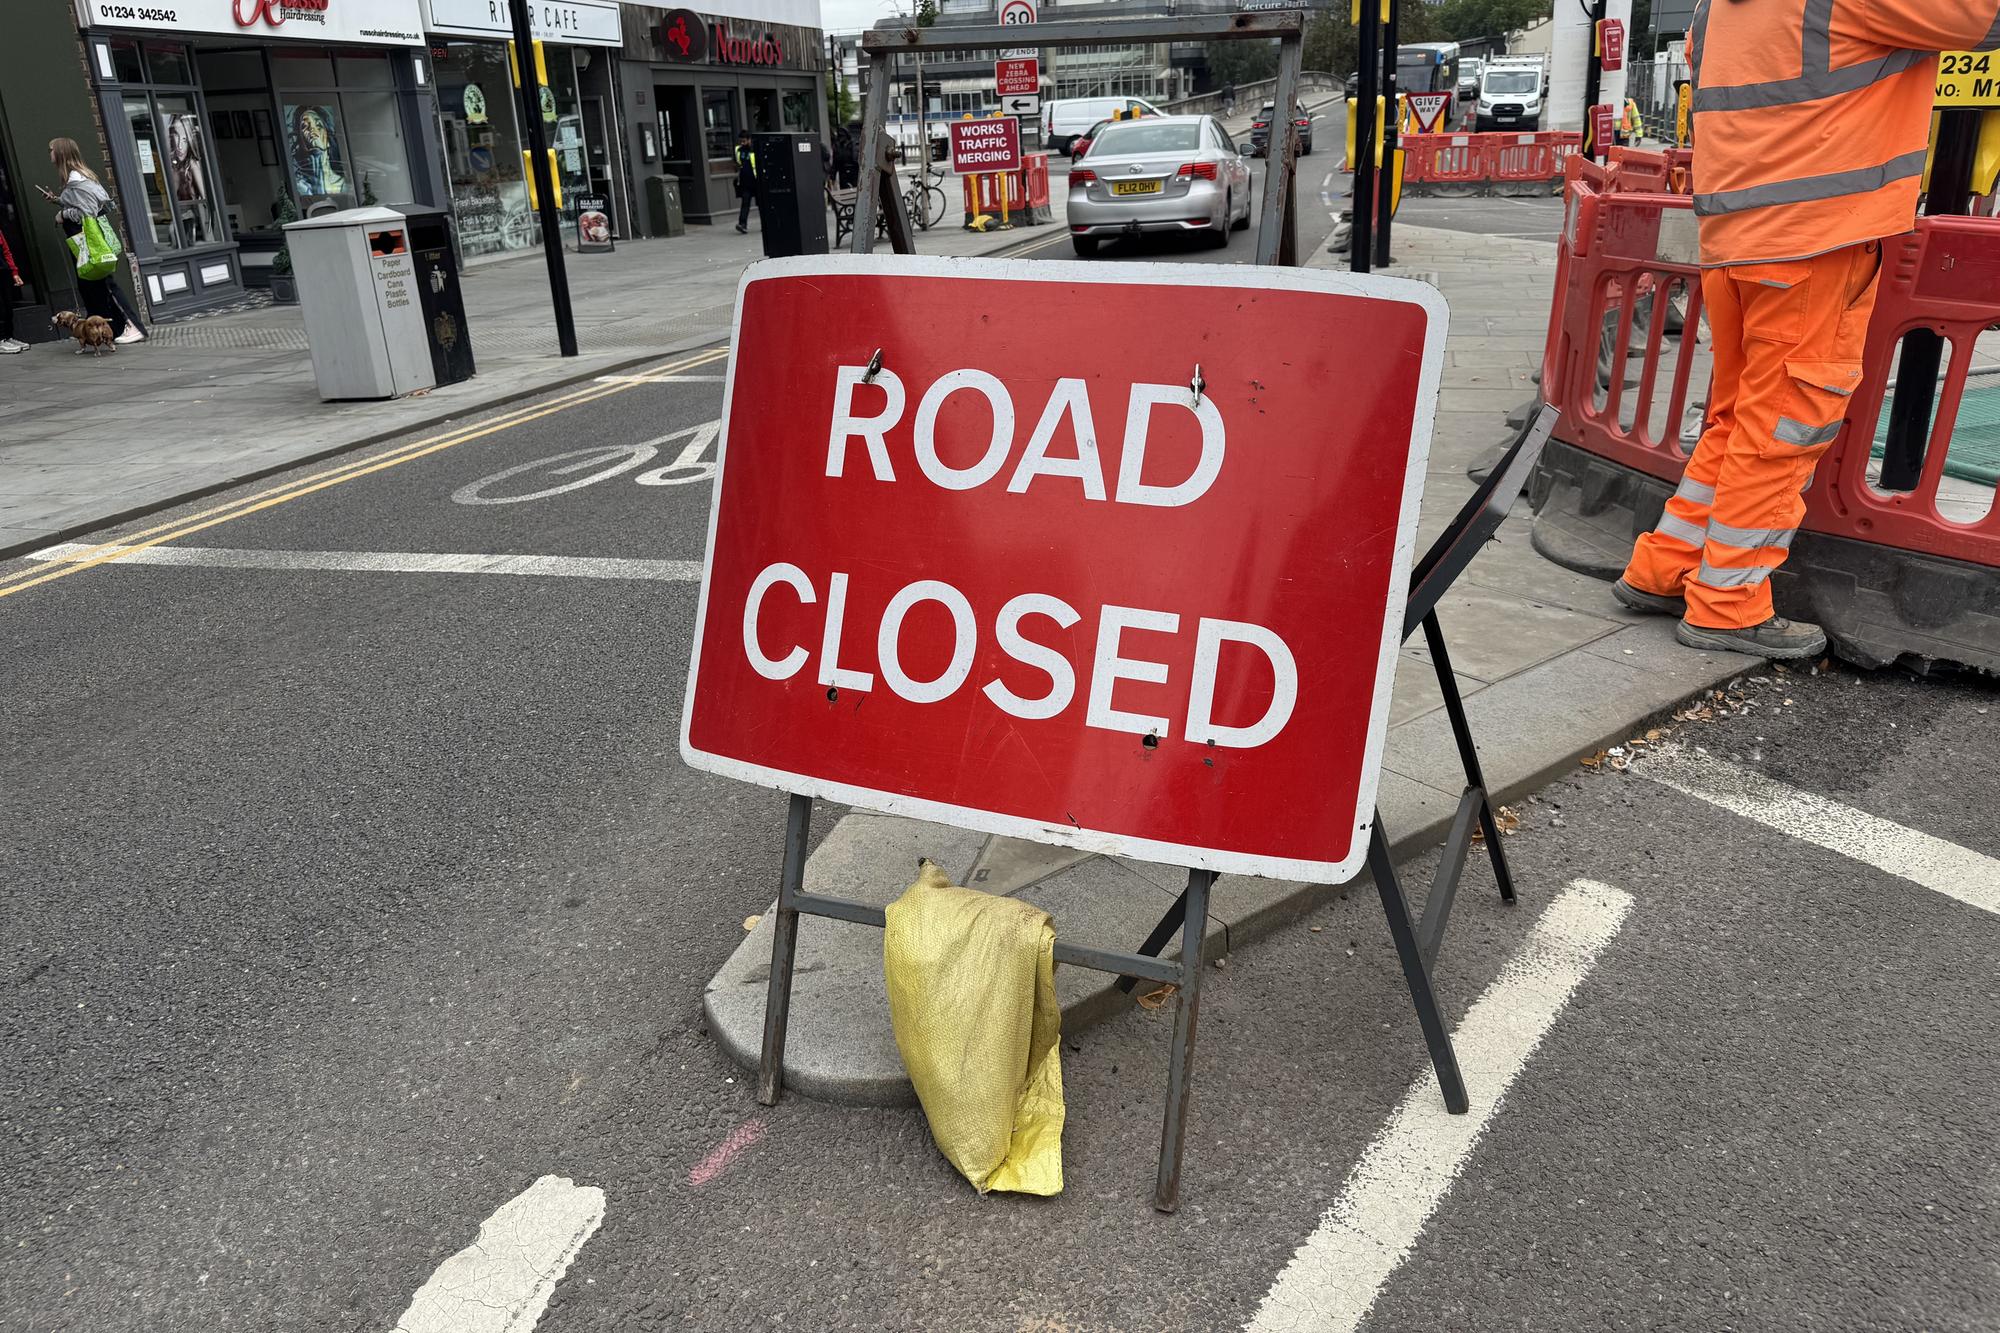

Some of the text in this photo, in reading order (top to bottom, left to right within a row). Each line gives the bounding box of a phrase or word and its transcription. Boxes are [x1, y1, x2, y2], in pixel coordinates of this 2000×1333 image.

[100, 4, 178, 22] 01234 342542
[279, 8, 326, 26] Hairdressing
[489, 0, 578, 30] RIR CAFE
[1006, 11, 1030, 25] 30
[715, 22, 783, 65] Nando's
[1015, 47, 1036, 56] ENDS
[1006, 69, 1028, 77] ZEBRA
[999, 76, 1036, 85] CROSSING
[1005, 83, 1030, 92] AHEAD
[1415, 97, 1441, 106] GIVE
[960, 123, 1004, 137] WORKS
[958, 137, 1008, 150] TRAFFIC
[957, 150, 1011, 164] MERGING
[1118, 181, 1156, 193] FL12 OHV
[382, 259, 401, 269] Paper
[377, 268, 411, 280] Cardboard
[387, 280, 404, 289] Cans
[385, 289, 407, 299] Plastic
[387, 298, 410, 309] Bottles
[824, 364, 1227, 508] ROAD
[742, 561, 1299, 750] CLOSED
